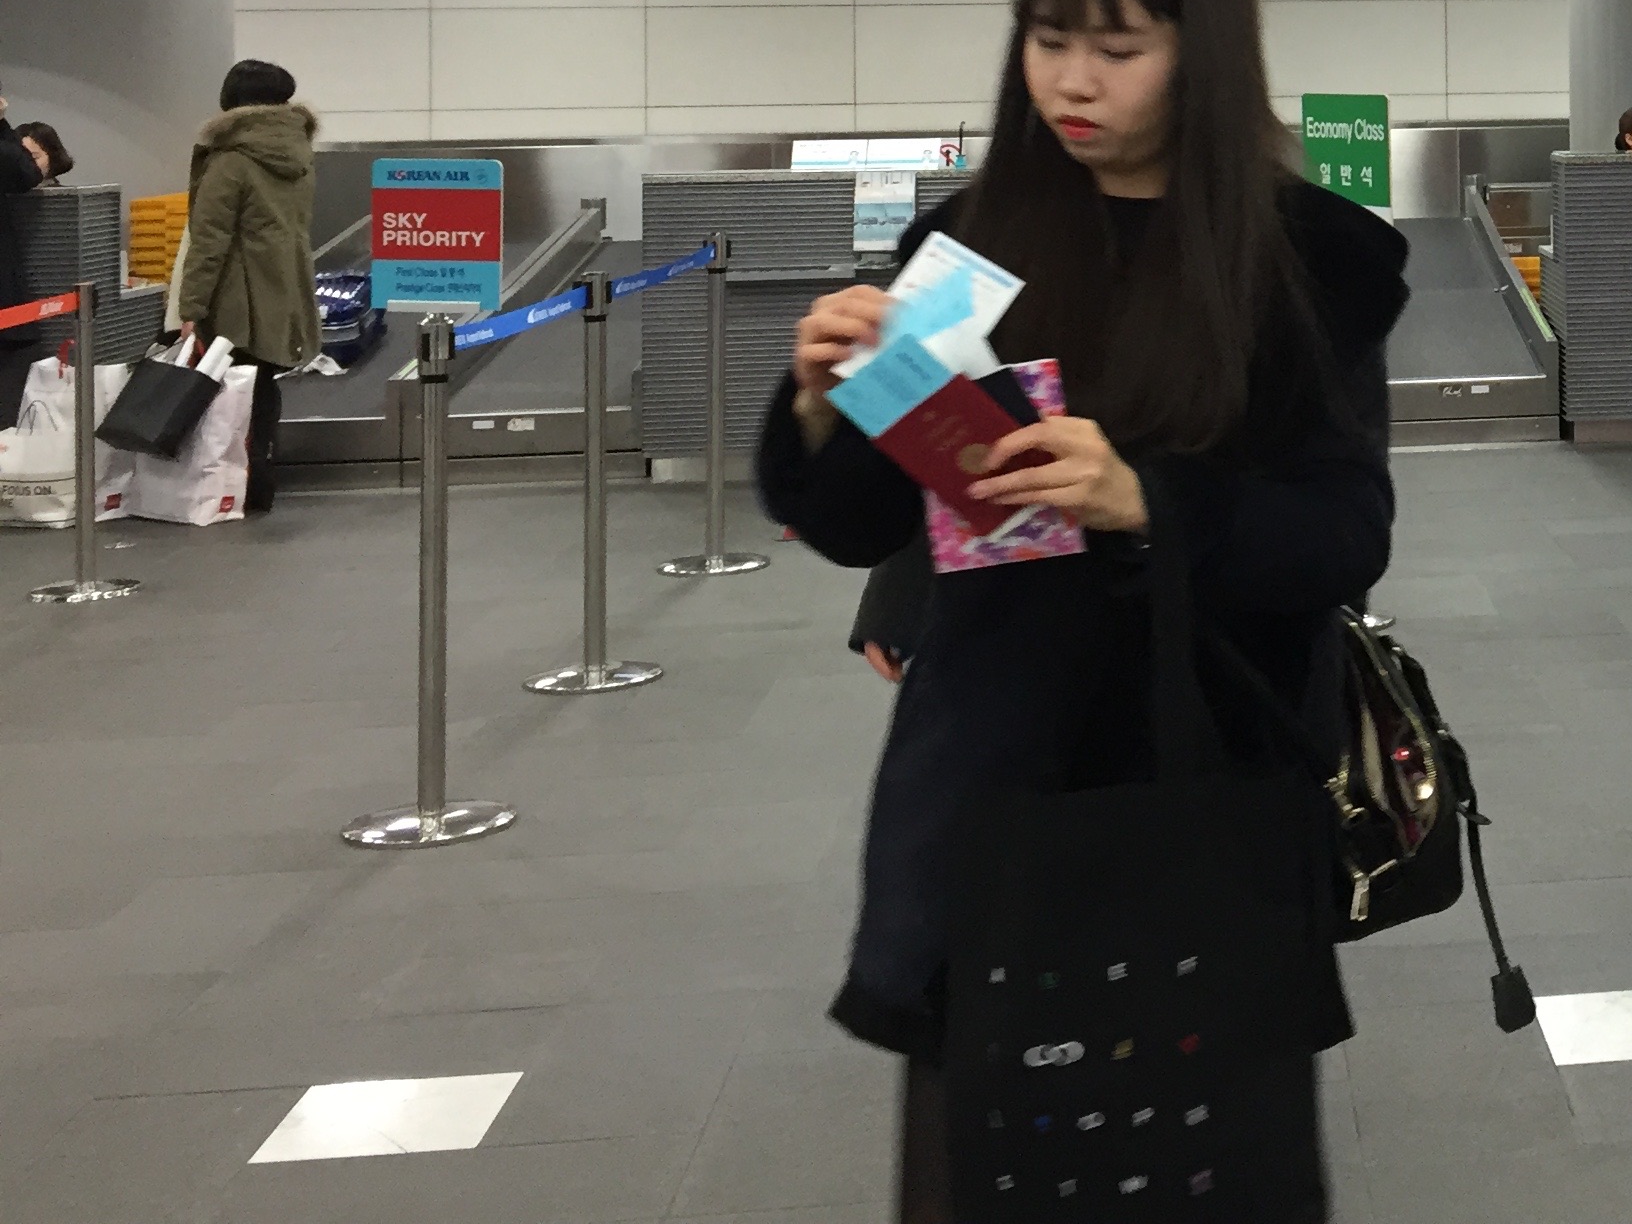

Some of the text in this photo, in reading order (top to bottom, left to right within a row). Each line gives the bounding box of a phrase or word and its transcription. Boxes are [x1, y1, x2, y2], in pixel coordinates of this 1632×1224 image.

[1306, 116, 1385, 145] Economy Class
[386, 170, 471, 182] KOREAN AIR
[381, 212, 428, 229] SKY
[381, 230, 486, 247] PRIORITY
